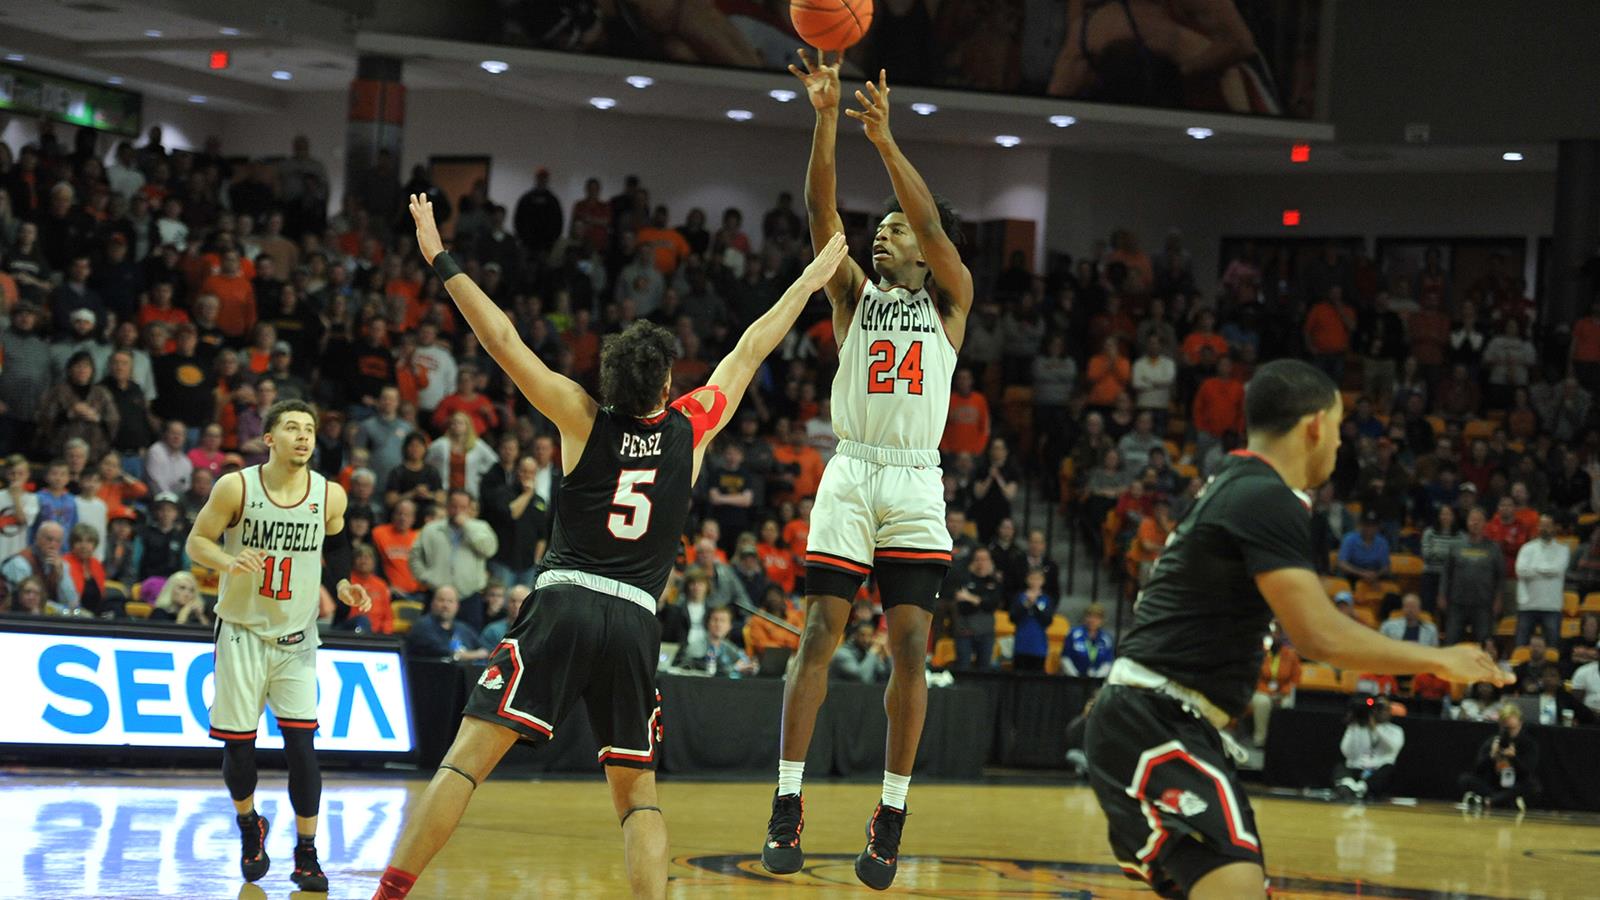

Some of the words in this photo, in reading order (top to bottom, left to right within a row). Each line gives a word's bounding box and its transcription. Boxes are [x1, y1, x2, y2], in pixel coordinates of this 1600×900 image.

[861, 294, 936, 333] CAMPBELL
[868, 339, 924, 396] 24
[620, 432, 662, 458] PEREZ
[607, 468, 658, 542] 5
[241, 518, 318, 551] CAMPBELL
[259, 555, 292, 600] 11
[37, 643, 396, 740] SEA
